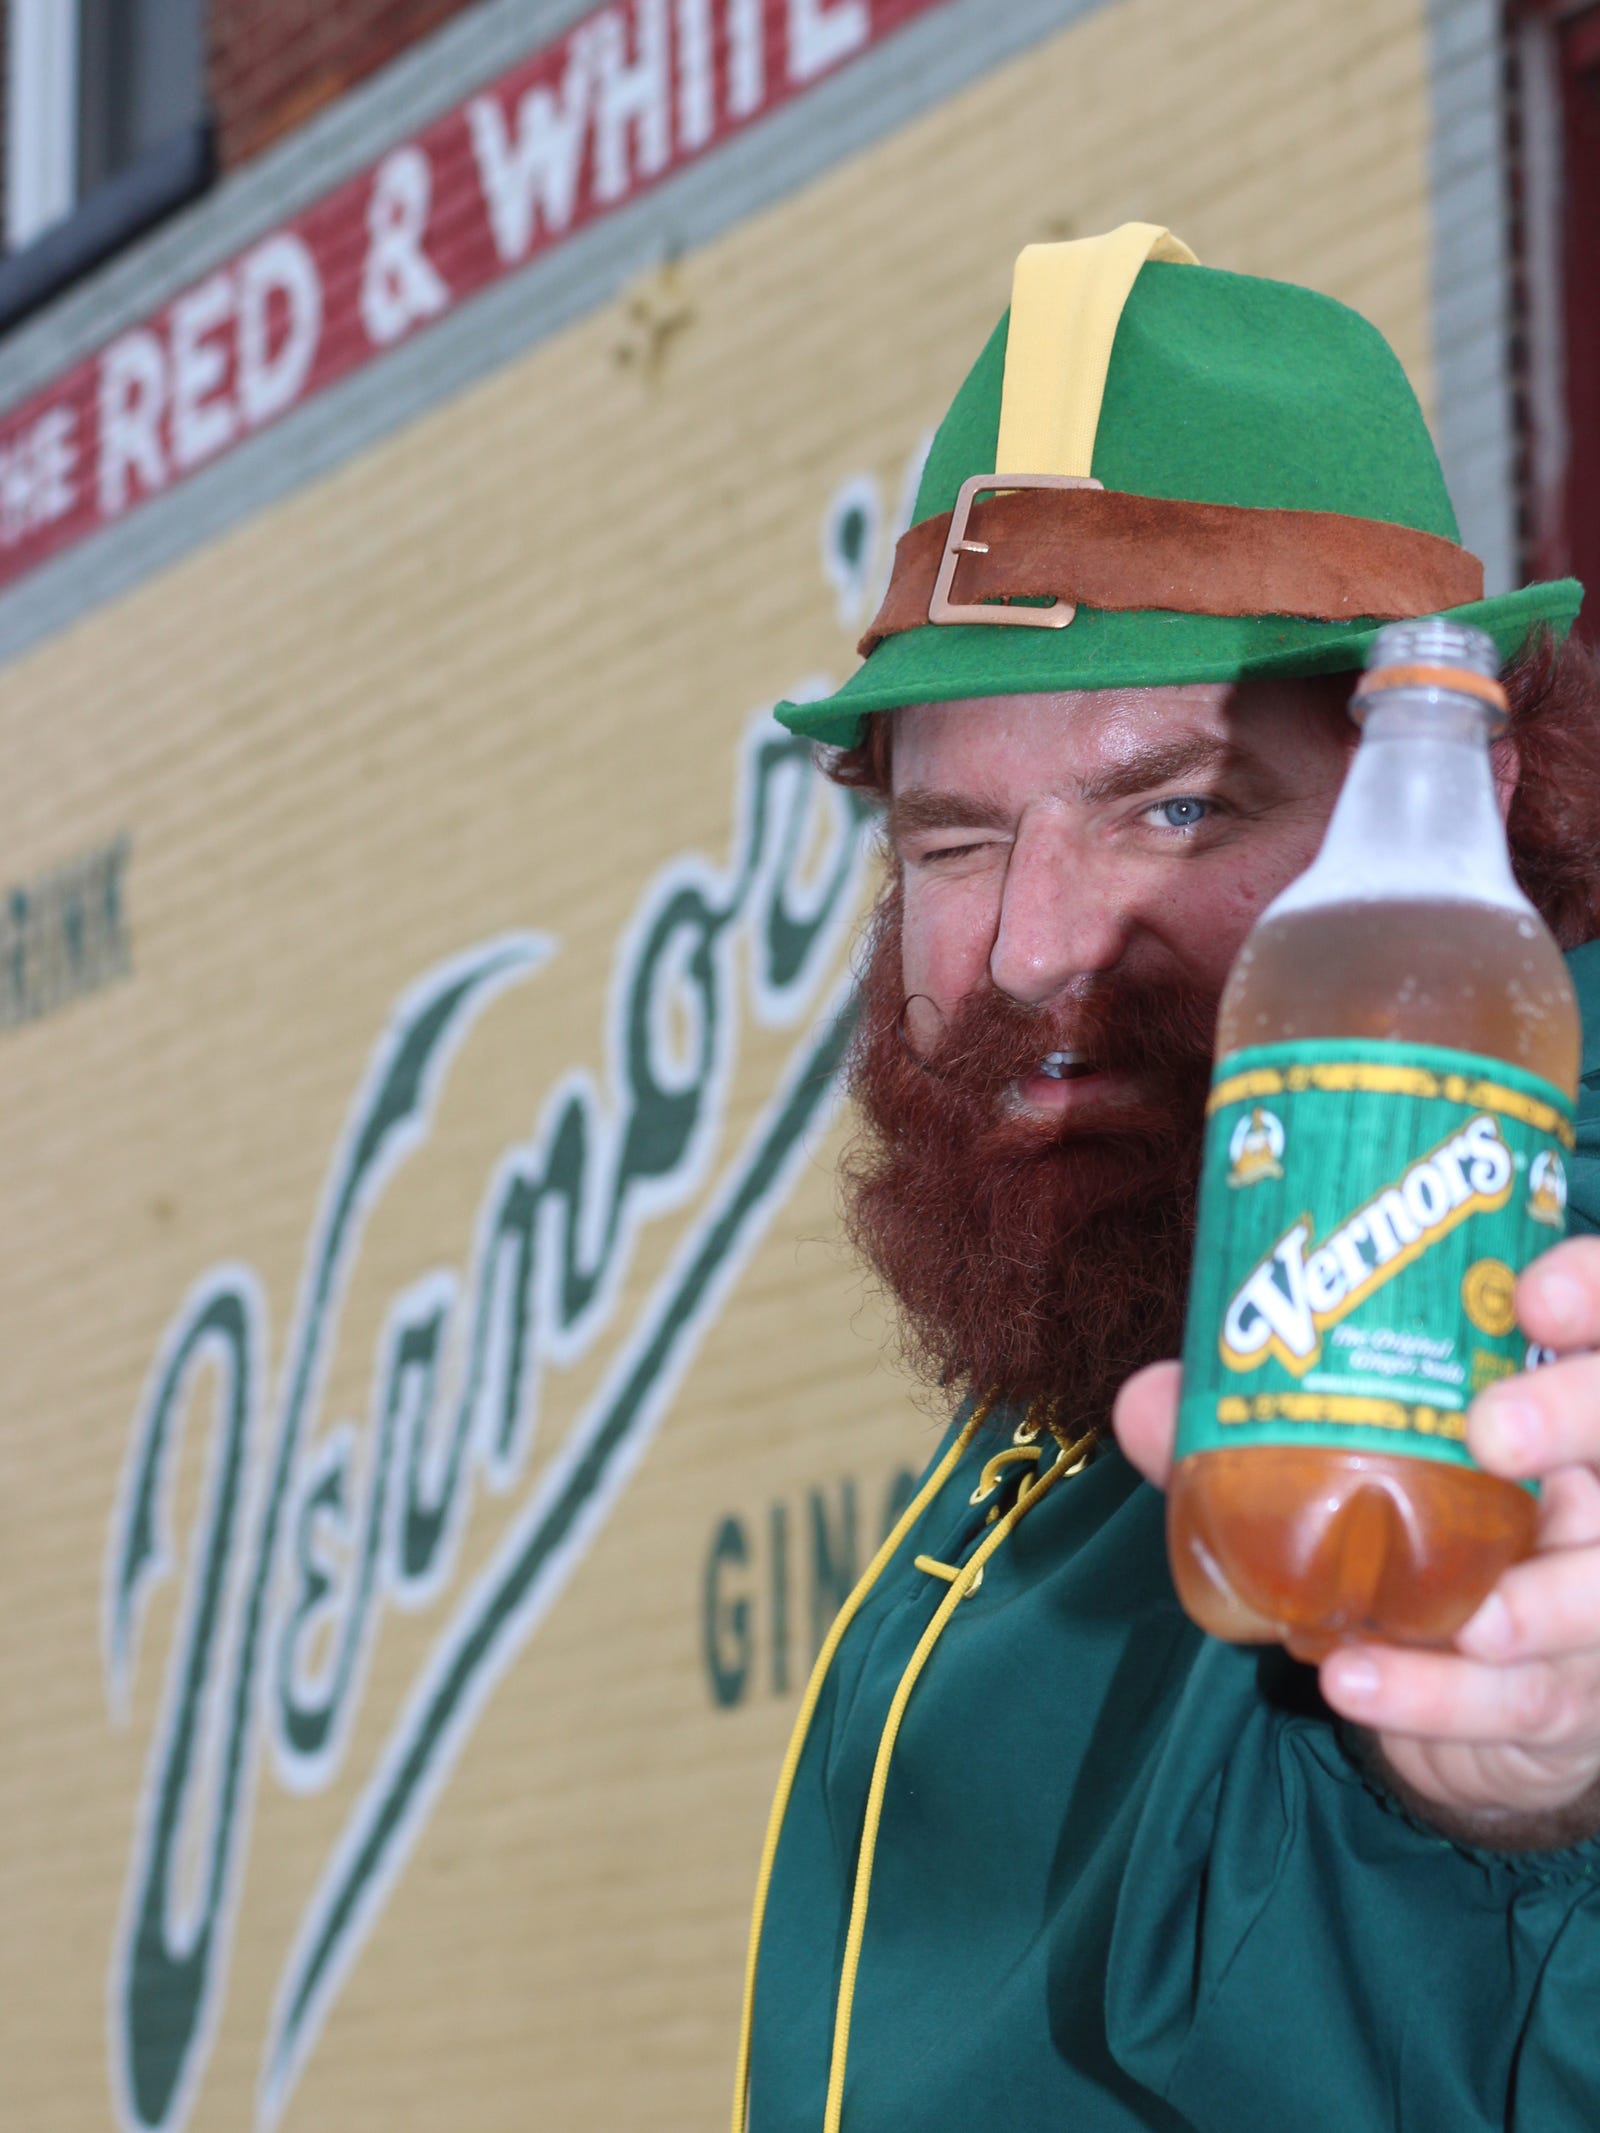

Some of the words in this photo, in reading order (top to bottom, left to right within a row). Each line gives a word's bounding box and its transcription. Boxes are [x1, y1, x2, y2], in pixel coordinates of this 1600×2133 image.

[99, 231, 322, 516] RED
[361, 145, 451, 346] &
[106, 435, 935, 2133] Vernor'
[1222, 1112, 1514, 1364] Vernors
